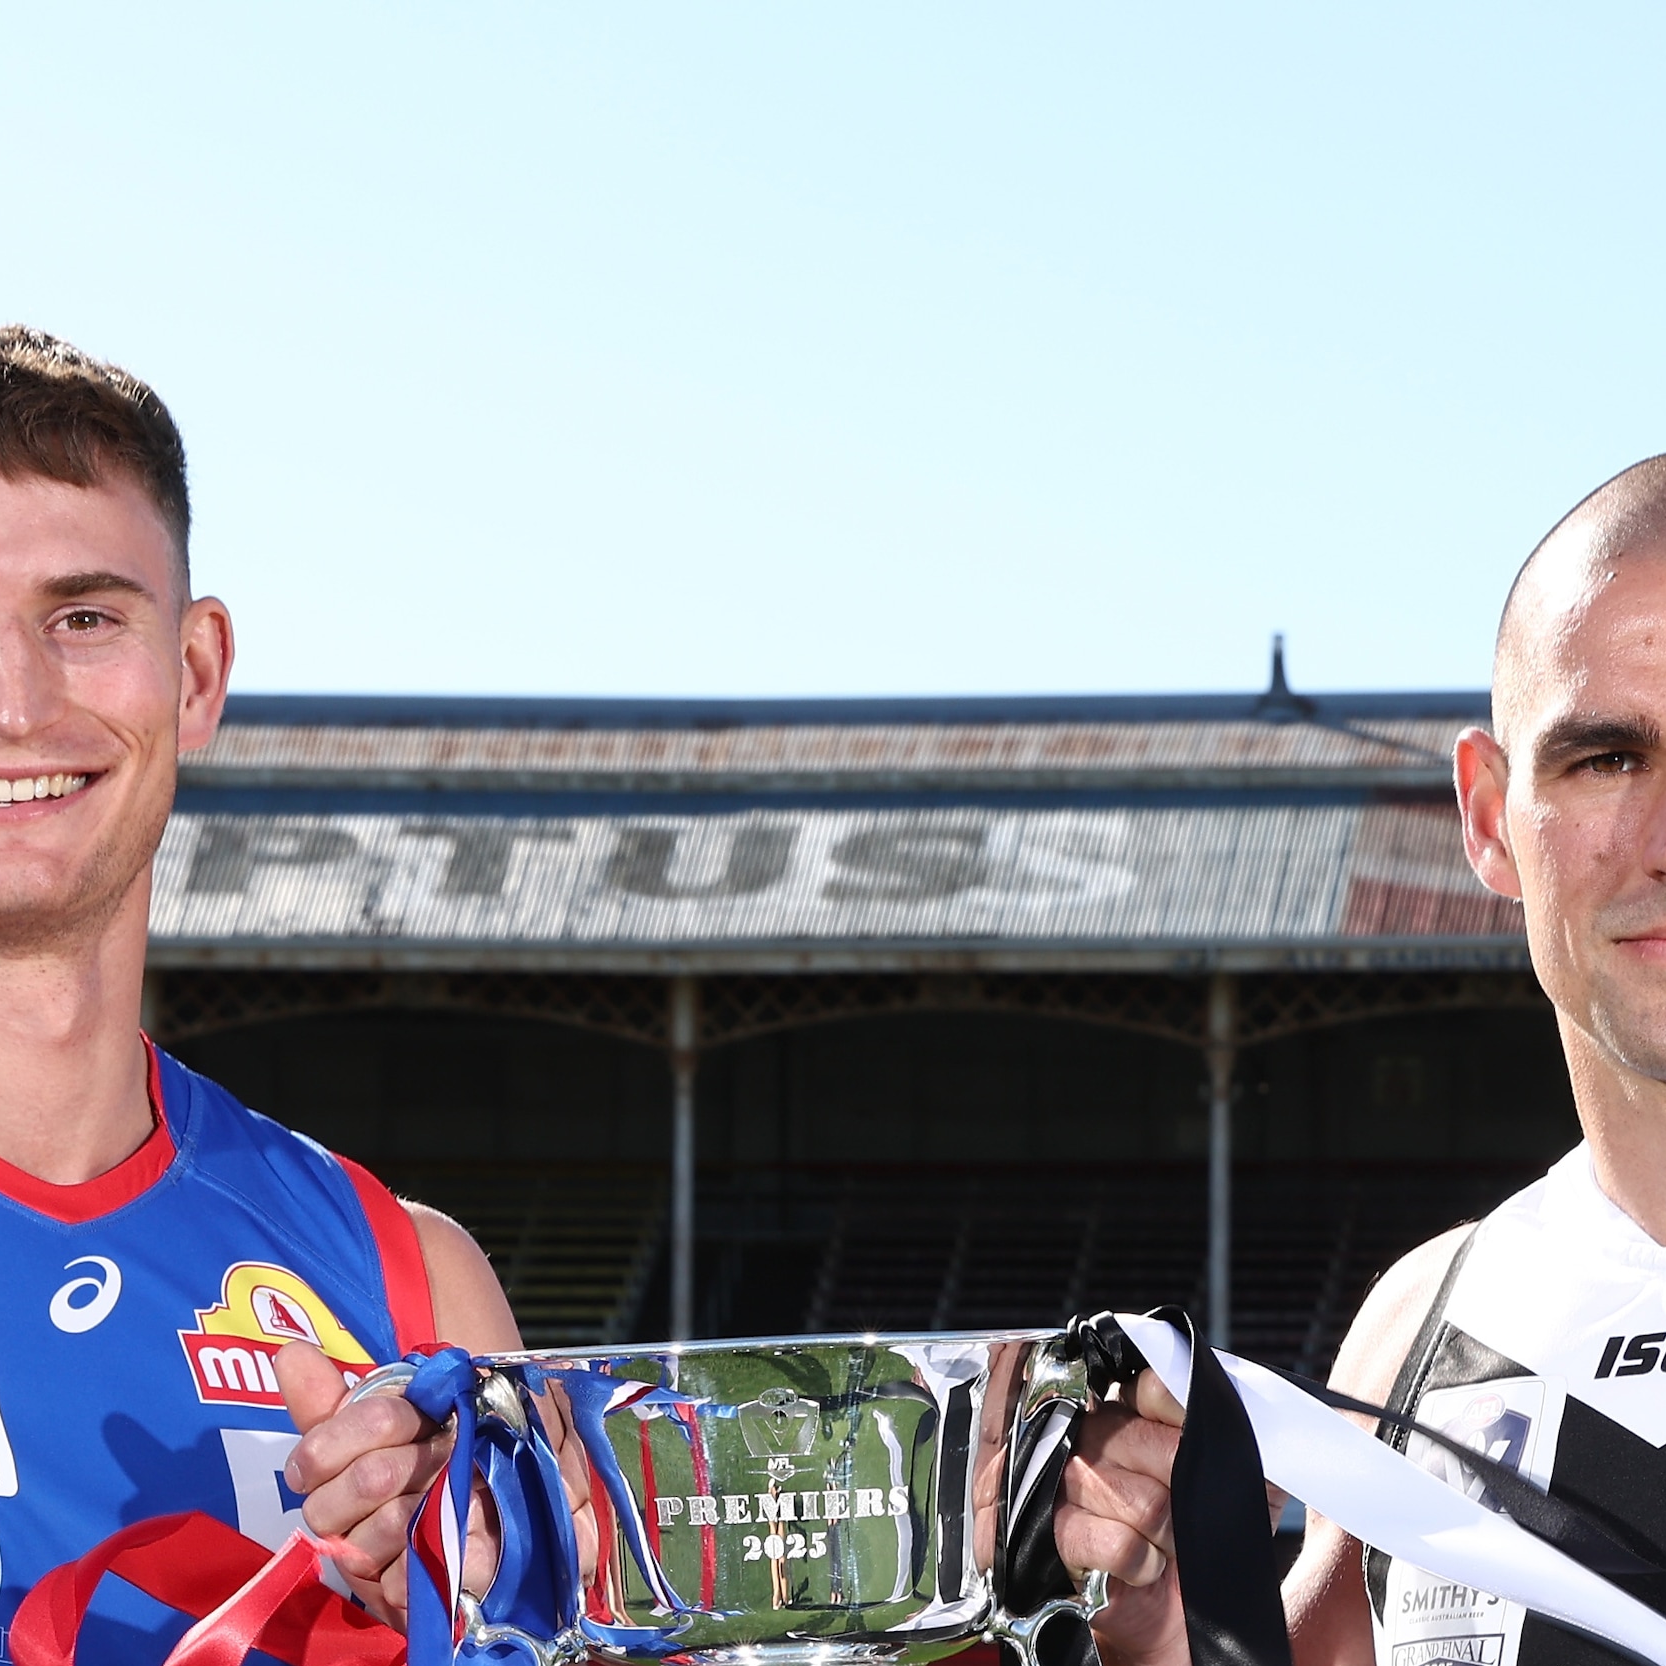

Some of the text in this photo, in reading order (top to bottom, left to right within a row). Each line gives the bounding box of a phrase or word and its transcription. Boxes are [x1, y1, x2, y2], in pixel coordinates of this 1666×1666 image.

[653, 1485, 910, 1527] PREMIERS
[742, 1531, 828, 1562] 2025
[1401, 1584, 1500, 1614] SMITHY
[1441, 1638, 1497, 1666] FINAL
